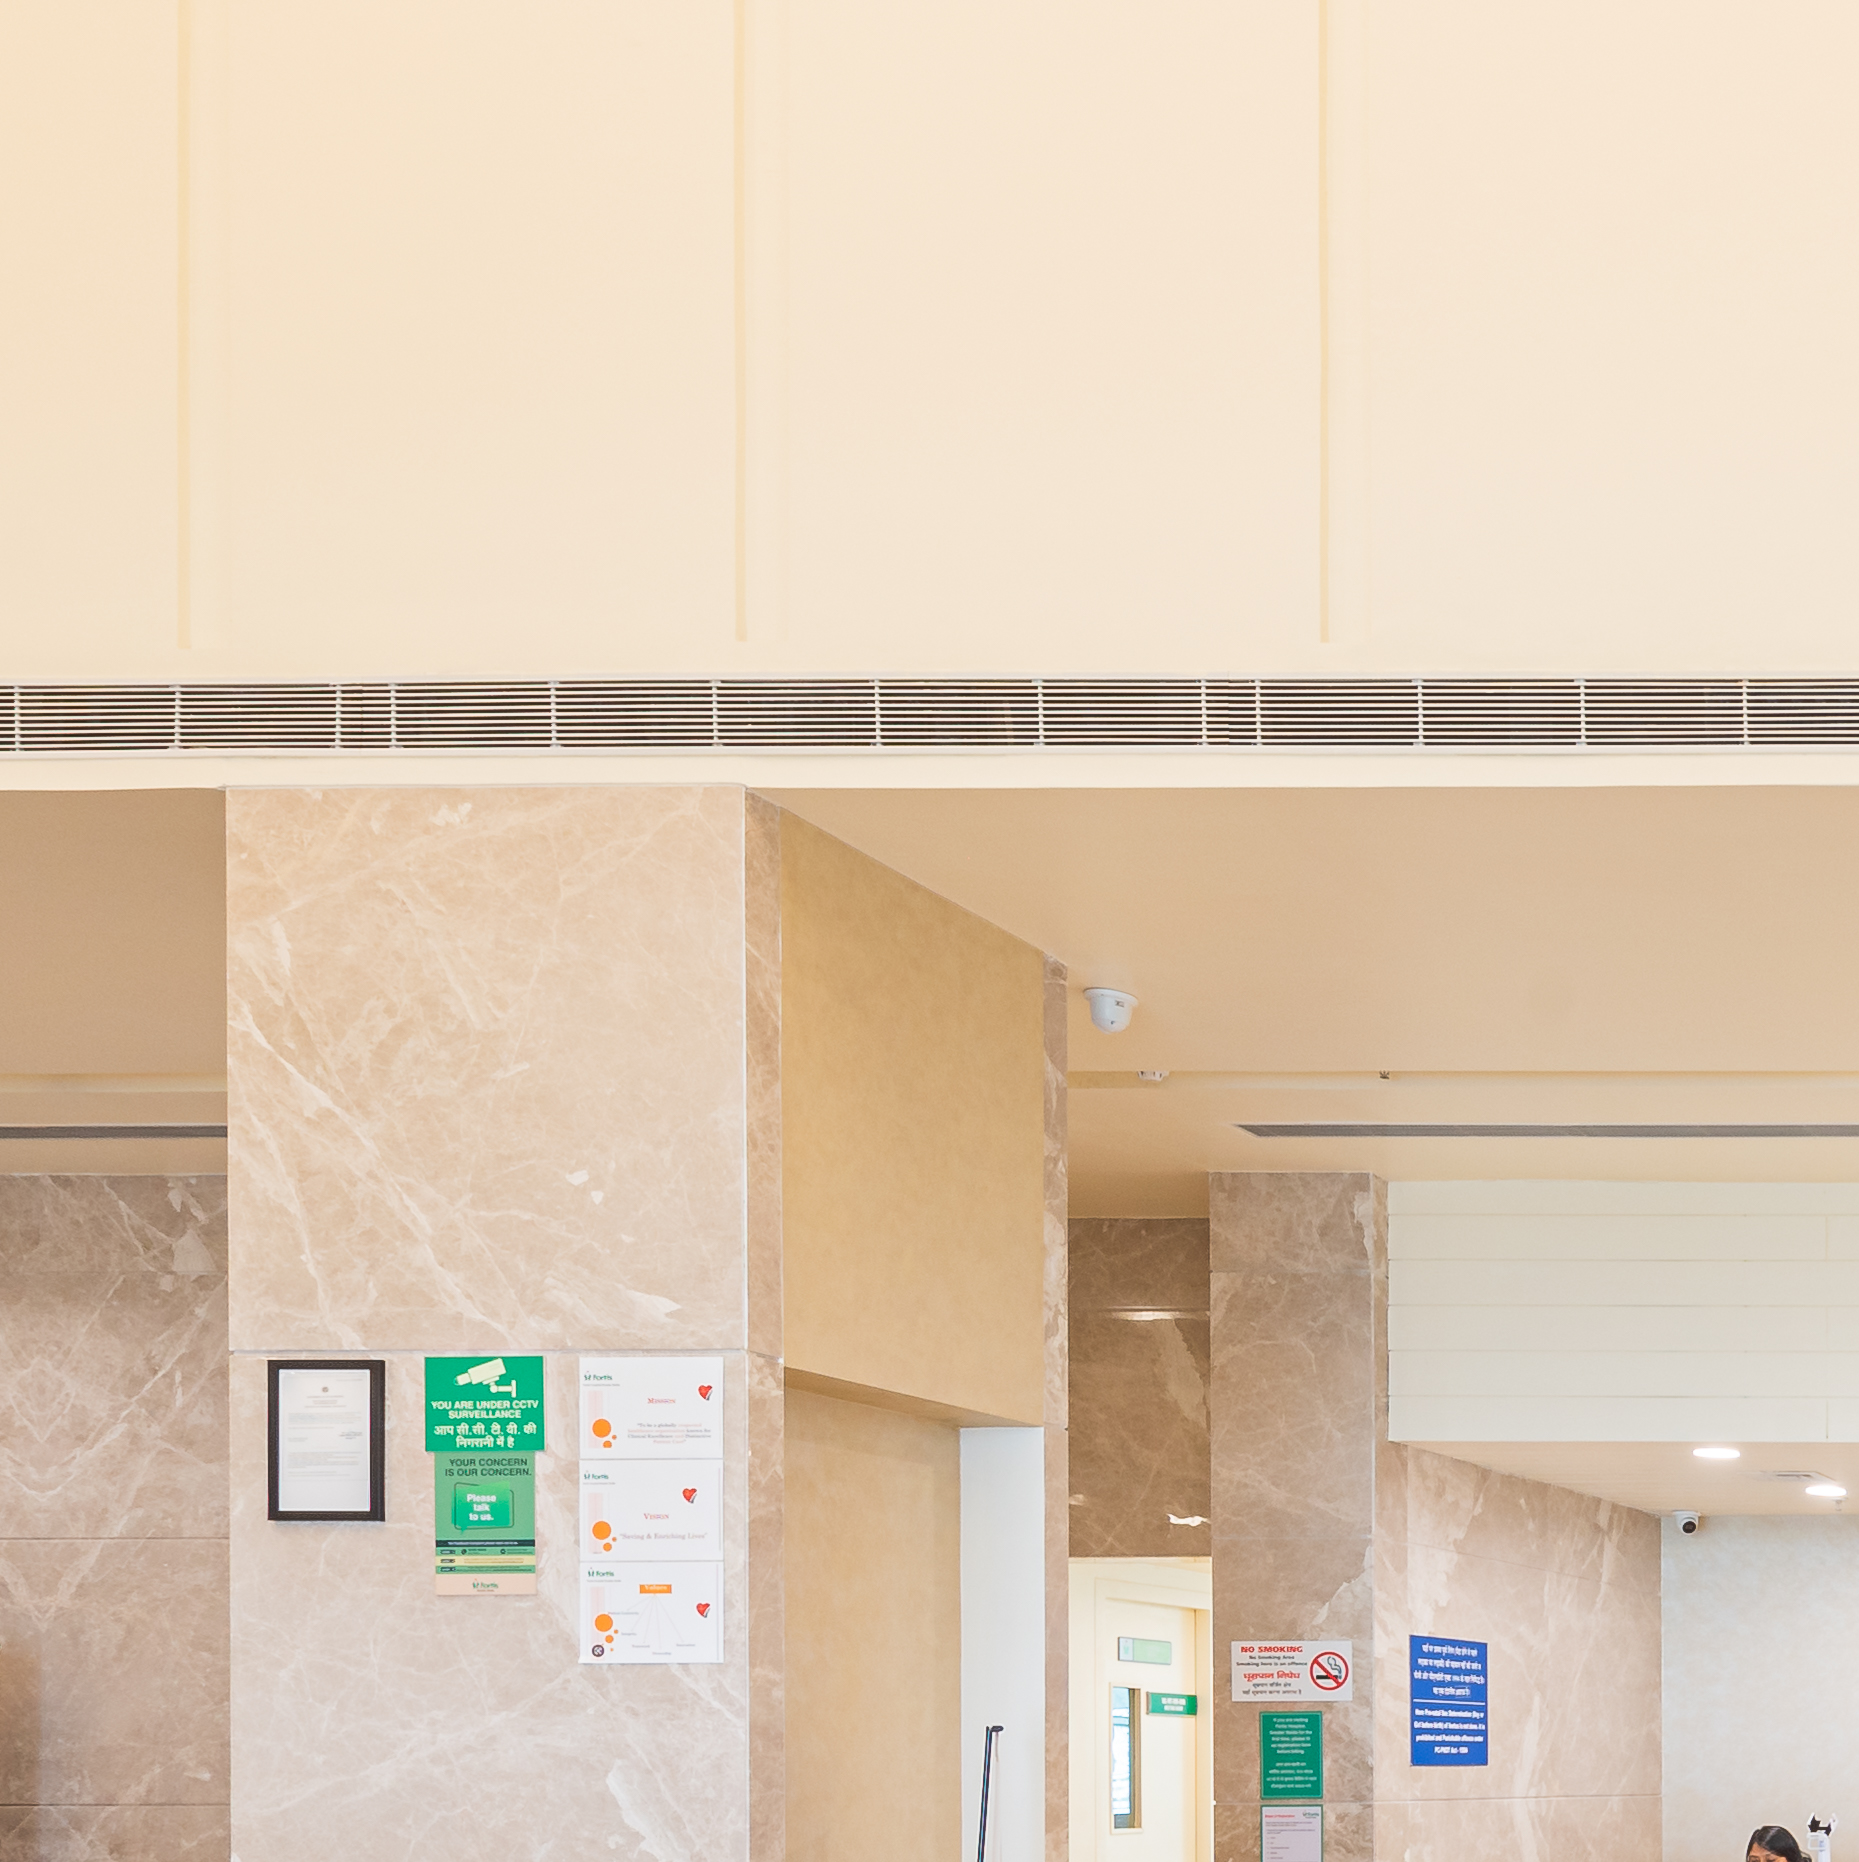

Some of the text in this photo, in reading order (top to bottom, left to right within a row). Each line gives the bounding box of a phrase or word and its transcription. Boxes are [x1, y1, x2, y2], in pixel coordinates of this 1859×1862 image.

[431, 1400, 539, 1410] YOU ARE UNDER CCTV
[449, 1410, 522, 1419] SURVEILLANCE
[434, 1425, 455, 1435] आप
[523, 1422, 537, 1435] की
[456, 1435, 515, 1449] निगरानी में है
[449, 1458, 528, 1467] YOUR CONCERN
[445, 1468, 532, 1477] IS OUR CONCERN.
[467, 1494, 497, 1503] Please
[473, 1503, 490, 1512] talk
[469, 1513, 494, 1521] to us.
